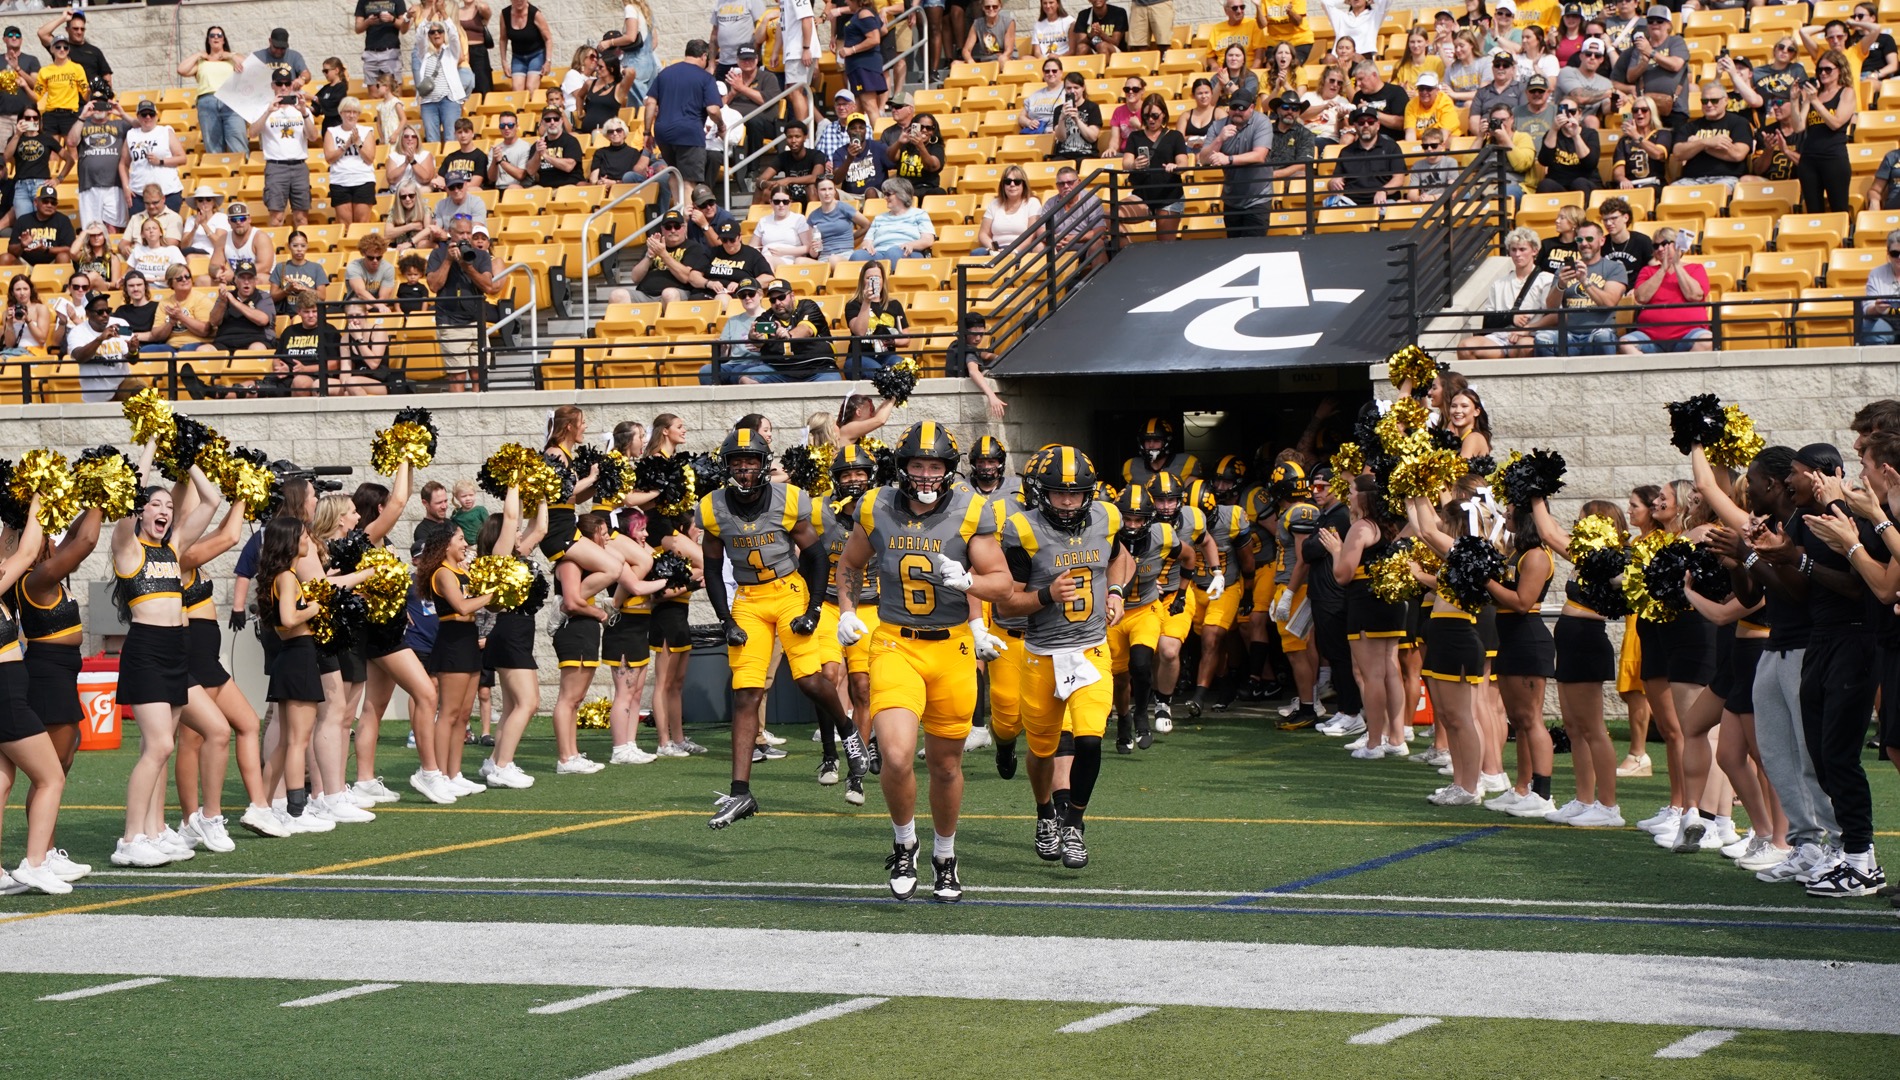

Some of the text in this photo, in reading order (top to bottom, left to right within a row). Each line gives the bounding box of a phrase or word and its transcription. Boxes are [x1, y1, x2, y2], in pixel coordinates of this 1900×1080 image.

[846, 165, 876, 183] CHAMPS
[710, 266, 734, 276] BAND
[1127, 251, 1366, 351] AC
[287, 334, 319, 349] ADRIA
[1301, 507, 1314, 520] 31
[732, 532, 776, 549] ADRIAN
[888, 535, 943, 553] ADRIAN
[746, 549, 778, 583] 1
[1055, 549, 1100, 567] ADRIAN
[145, 561, 182, 579] ADRIA
[899, 552, 937, 617] 6
[959, 641, 969, 656] AC
[93, 694, 112, 715] G
